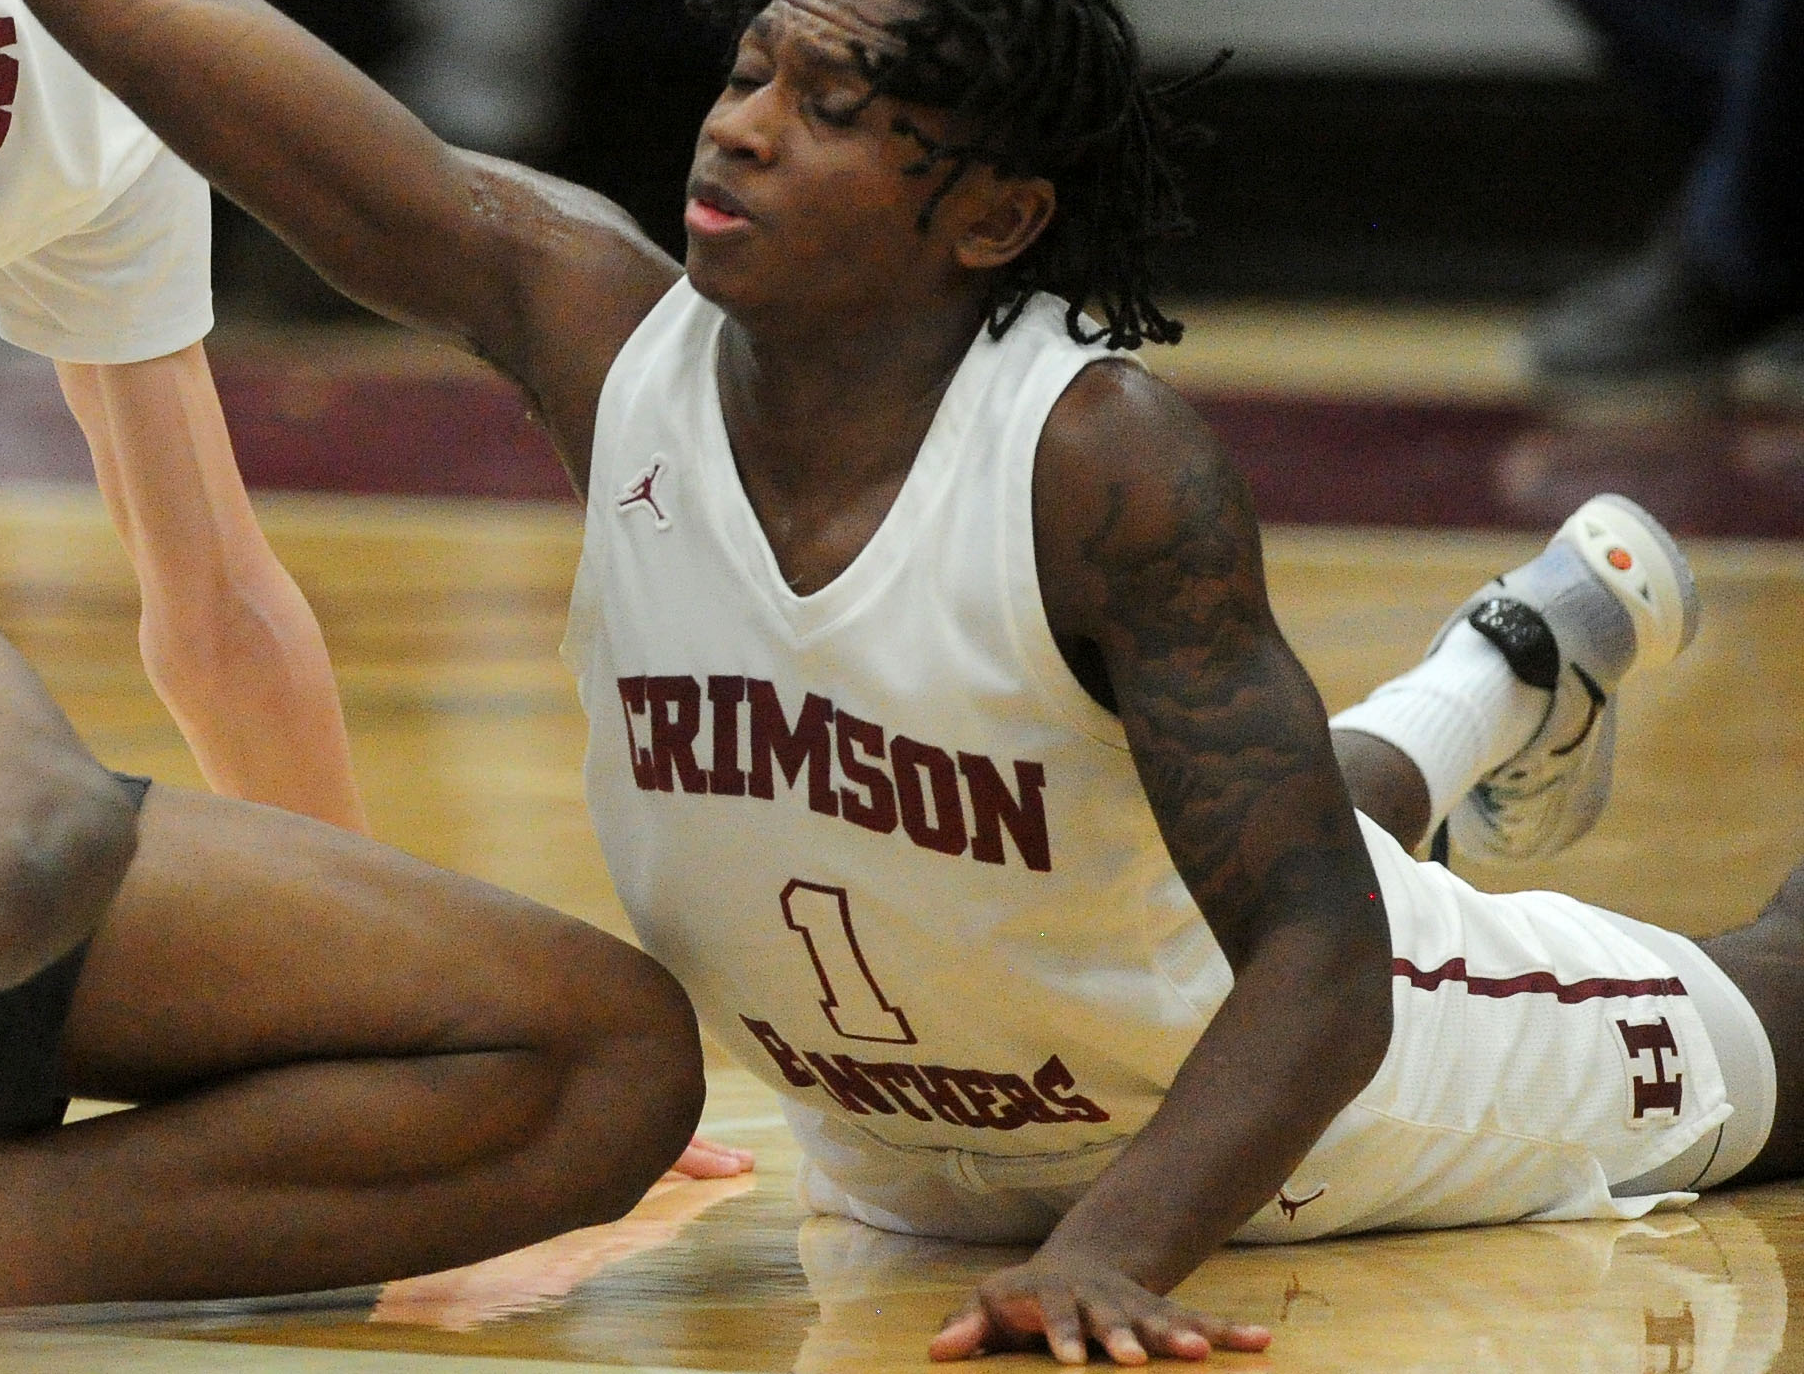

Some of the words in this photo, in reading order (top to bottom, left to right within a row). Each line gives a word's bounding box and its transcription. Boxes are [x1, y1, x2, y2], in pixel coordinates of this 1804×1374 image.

[617, 675, 1052, 873] CRIMSON
[779, 878, 918, 1045] 1
[1615, 1016, 1683, 1119] H
